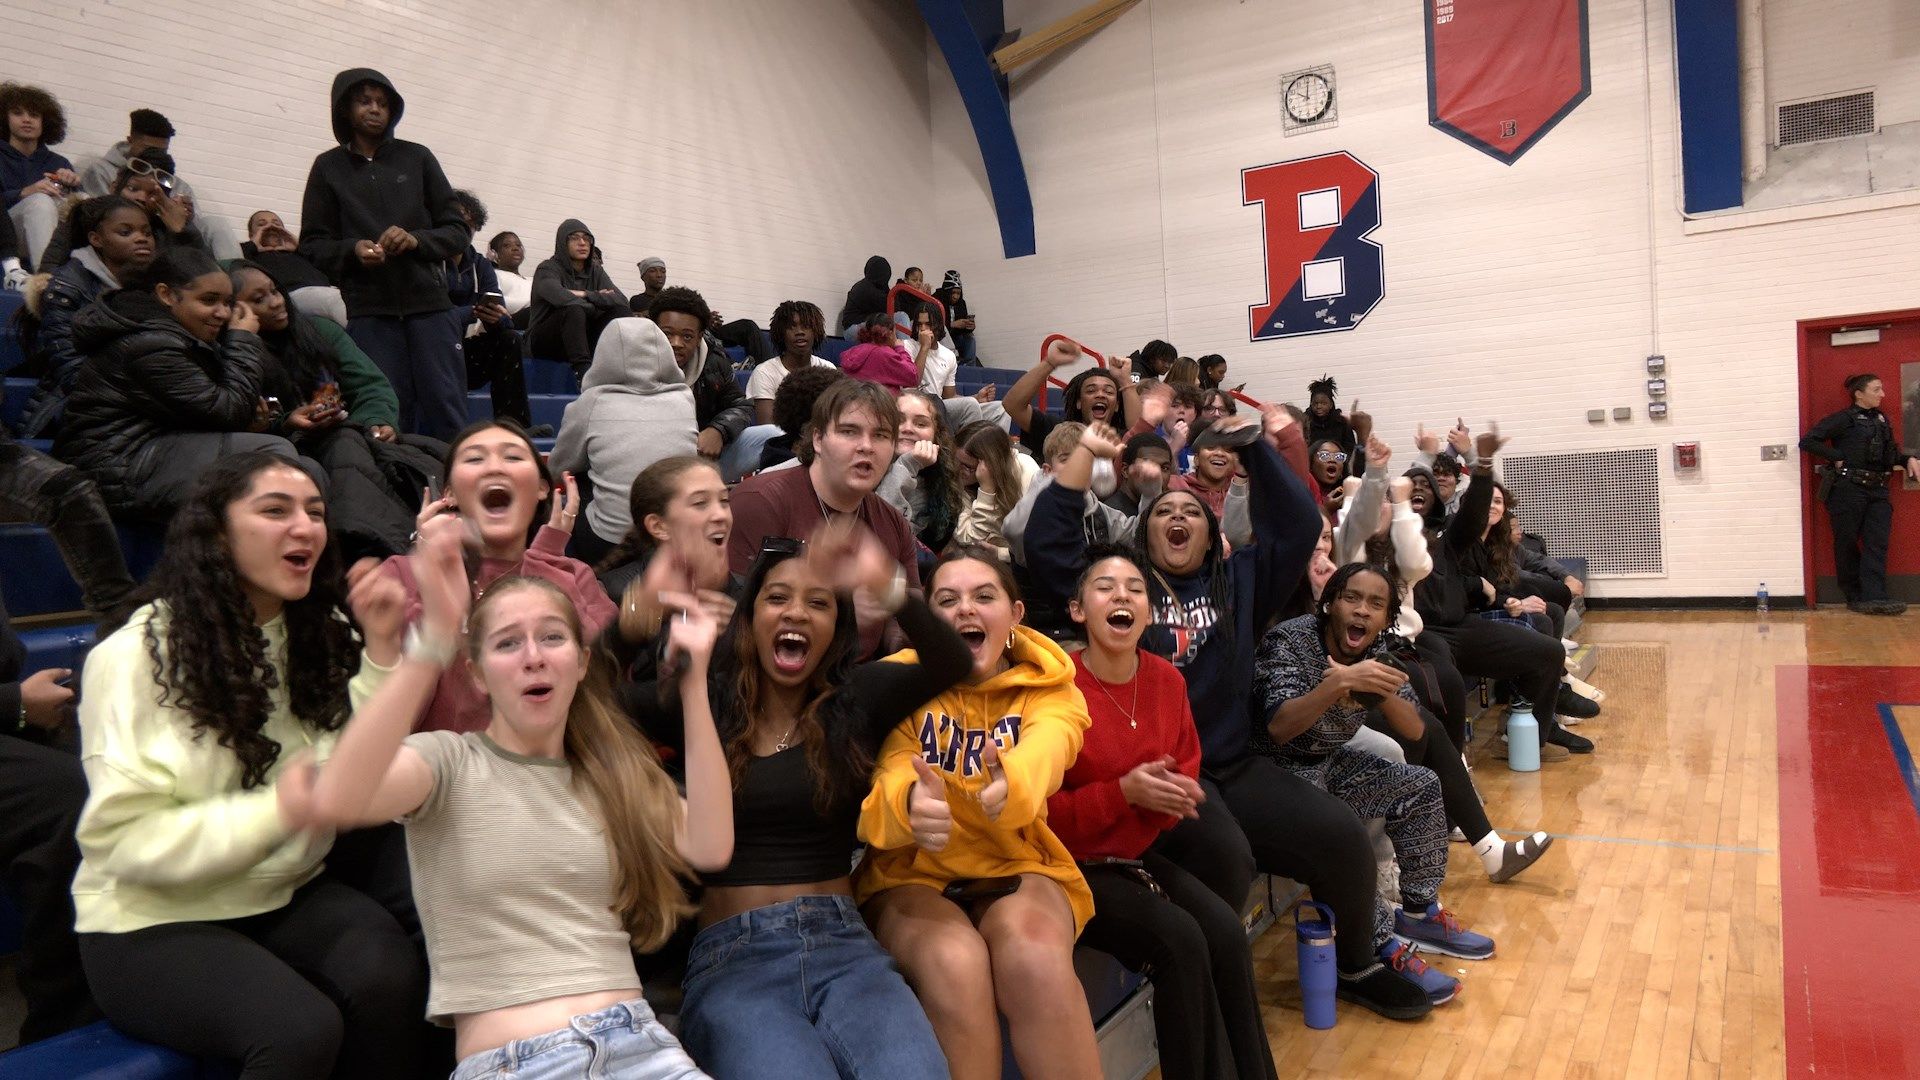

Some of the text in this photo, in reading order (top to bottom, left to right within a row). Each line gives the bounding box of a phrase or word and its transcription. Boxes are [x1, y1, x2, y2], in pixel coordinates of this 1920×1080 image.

[1436, 14, 1455, 24] 2017
[1500, 119, 1516, 138] B
[1240, 150, 1386, 342] B
